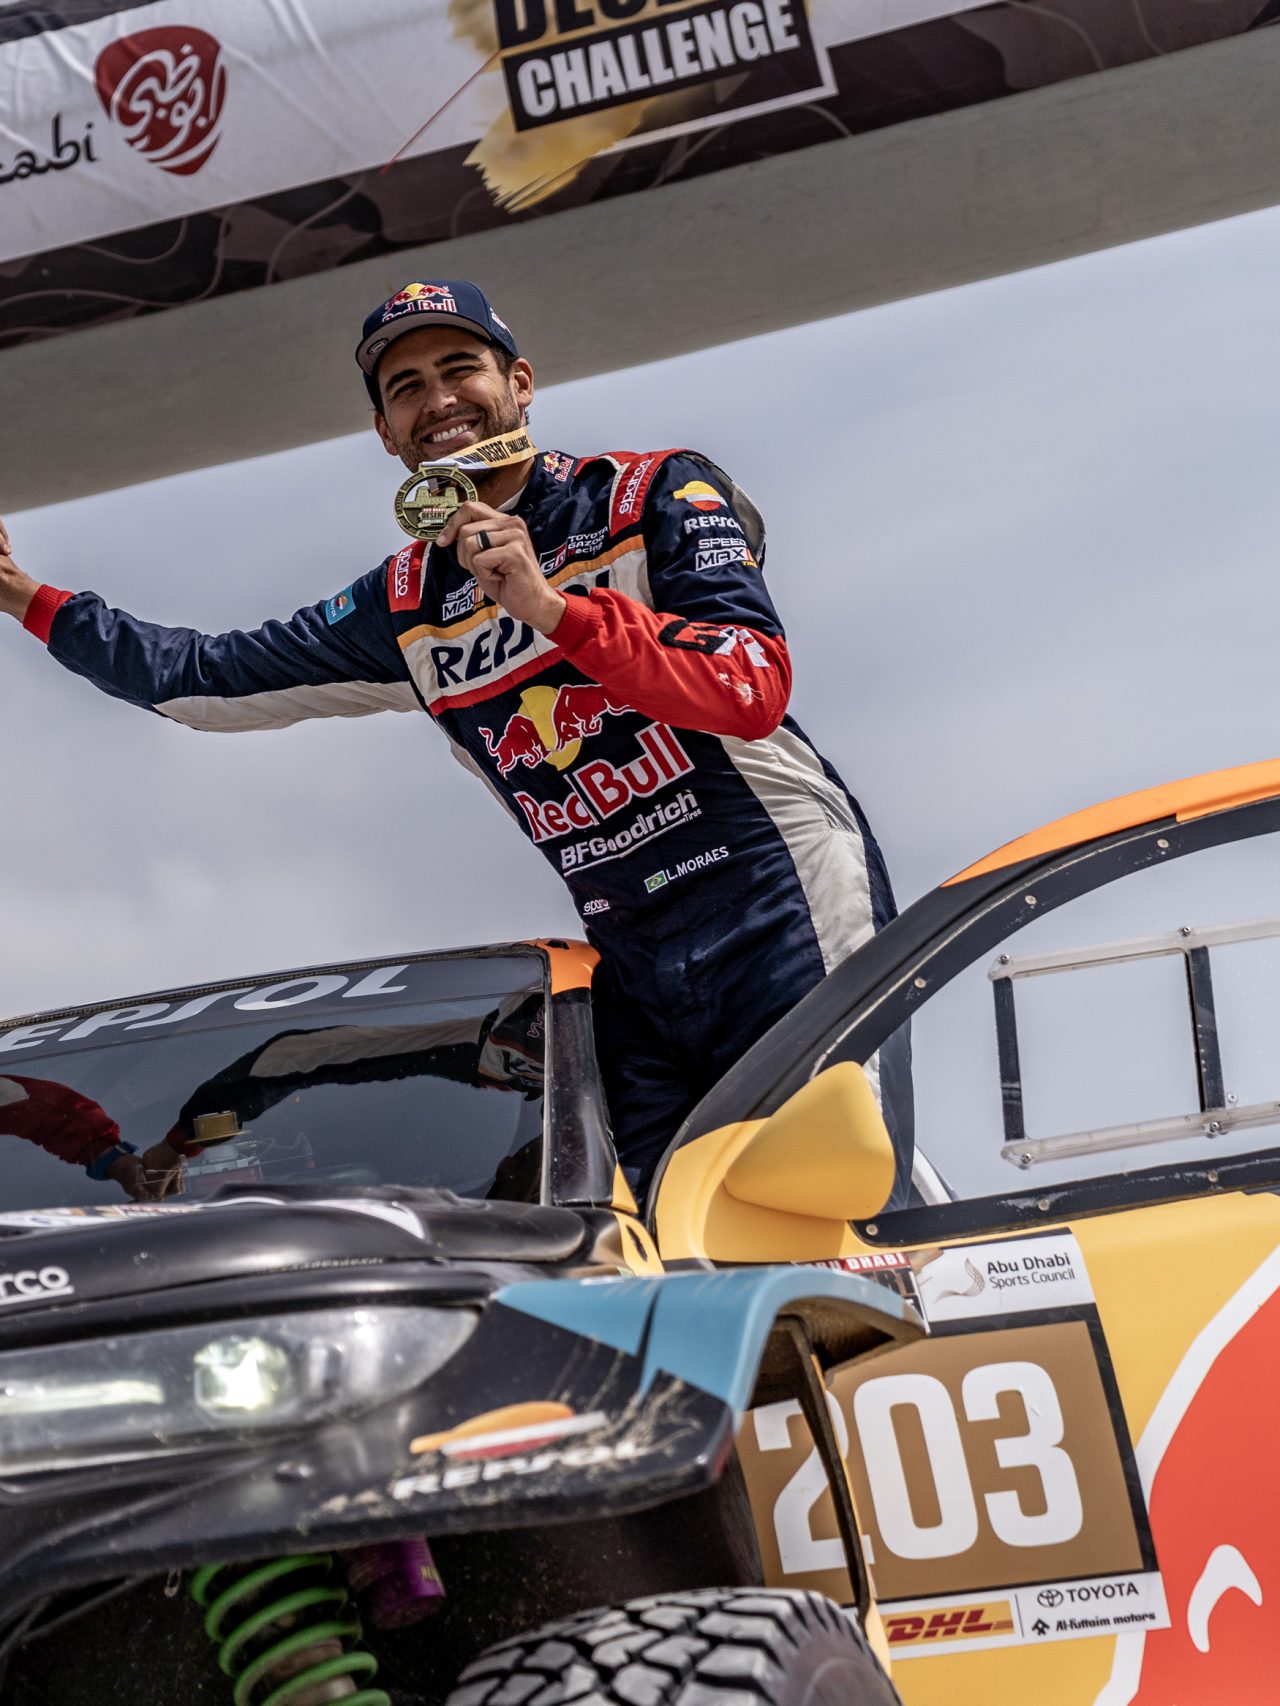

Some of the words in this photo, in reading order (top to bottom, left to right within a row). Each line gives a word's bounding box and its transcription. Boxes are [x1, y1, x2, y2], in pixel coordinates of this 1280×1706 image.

[517, 0, 801, 118] CHALLENGE
[382, 302, 415, 322] Rd
[418, 299, 457, 312] Bull
[477, 441, 510, 462] DESERT
[619, 459, 652, 513] sparco
[568, 526, 609, 541] TOYOTA
[568, 535, 604, 549] GAZOO
[699, 538, 746, 549] SPEED
[568, 542, 603, 557] Racing
[698, 548, 746, 569] MAX
[444, 590, 474, 619] MAX
[514, 774, 599, 843] Red
[573, 722, 695, 820] Bull
[561, 789, 698, 869] BFGoodrich
[667, 846, 729, 881] L.MORAES
[845, 1252, 906, 1271] DHABI
[987, 1258, 1021, 1275] Abu
[1023, 1252, 1071, 1272] Dhabi
[989, 1273, 1028, 1290] Sports
[1031, 1266, 1076, 1285] Council
[754, 1360, 1083, 1575] 203
[1067, 1582, 1139, 1602] TOYOTA
[886, 1608, 993, 1642] DHL
[1056, 1613, 1111, 1632] Al-Futtaim
[1113, 1611, 1156, 1625] motors
